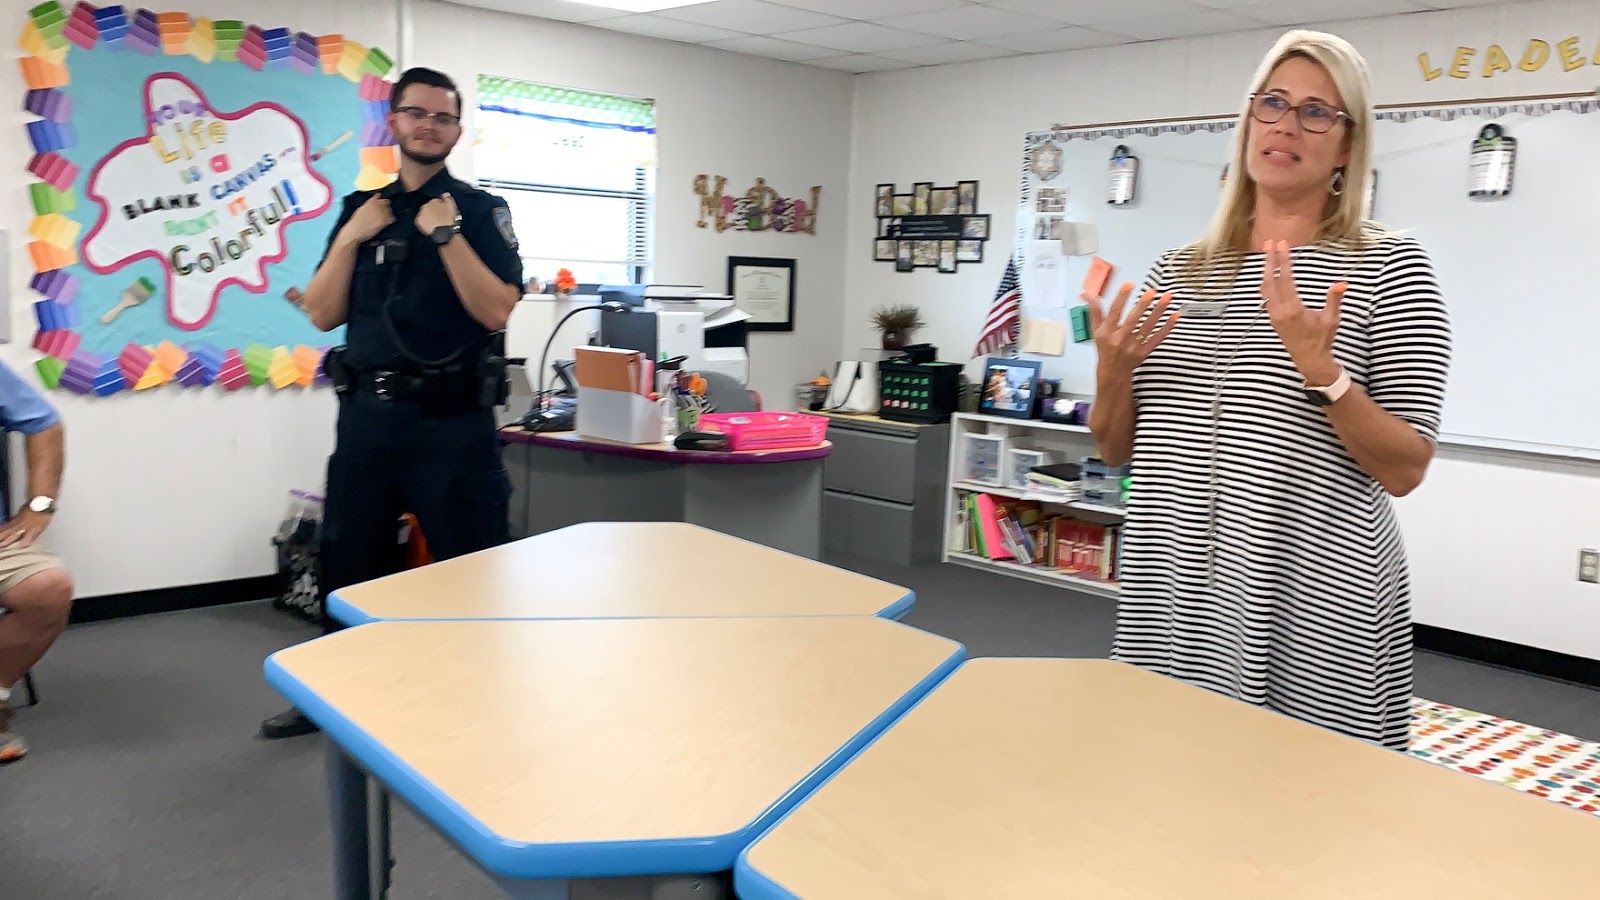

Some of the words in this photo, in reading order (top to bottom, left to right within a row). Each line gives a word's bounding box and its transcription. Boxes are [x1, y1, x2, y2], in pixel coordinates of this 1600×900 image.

[1416, 35, 1600, 82] LEADE
[150, 120, 226, 163] Life
[123, 193, 200, 219] BLANK
